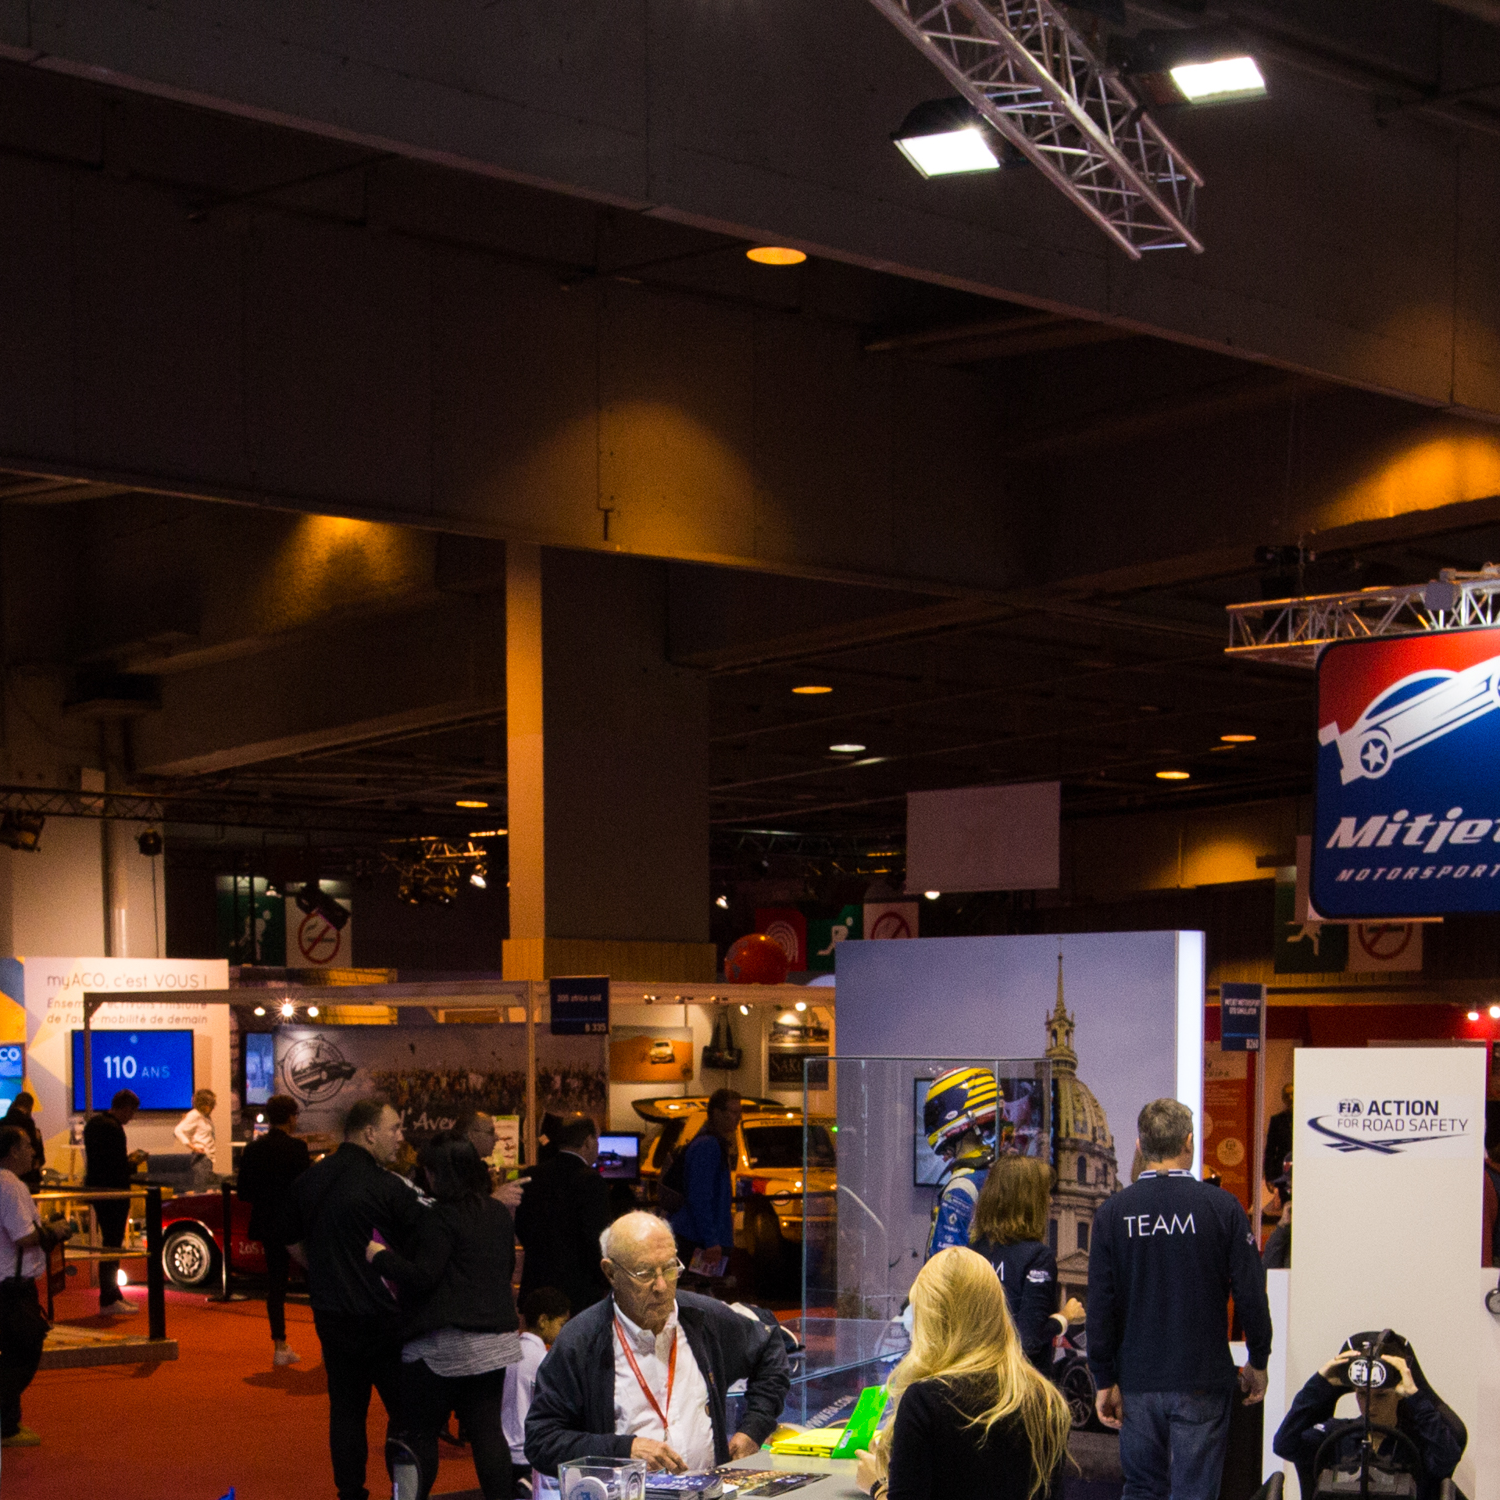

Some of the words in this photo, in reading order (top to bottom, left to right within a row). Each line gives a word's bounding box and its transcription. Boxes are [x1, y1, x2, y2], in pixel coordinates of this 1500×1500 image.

[153, 974, 200, 989] VOUS
[103, 1055, 138, 1080] 110
[141, 1066, 171, 1079] ANS
[1366, 1100, 1439, 1116] ACTION
[1337, 1118, 1359, 1129] FOR
[1362, 1118, 1405, 1132] ROAD
[1408, 1118, 1469, 1132] SAFETY
[1123, 1213, 1197, 1238] TEAM
